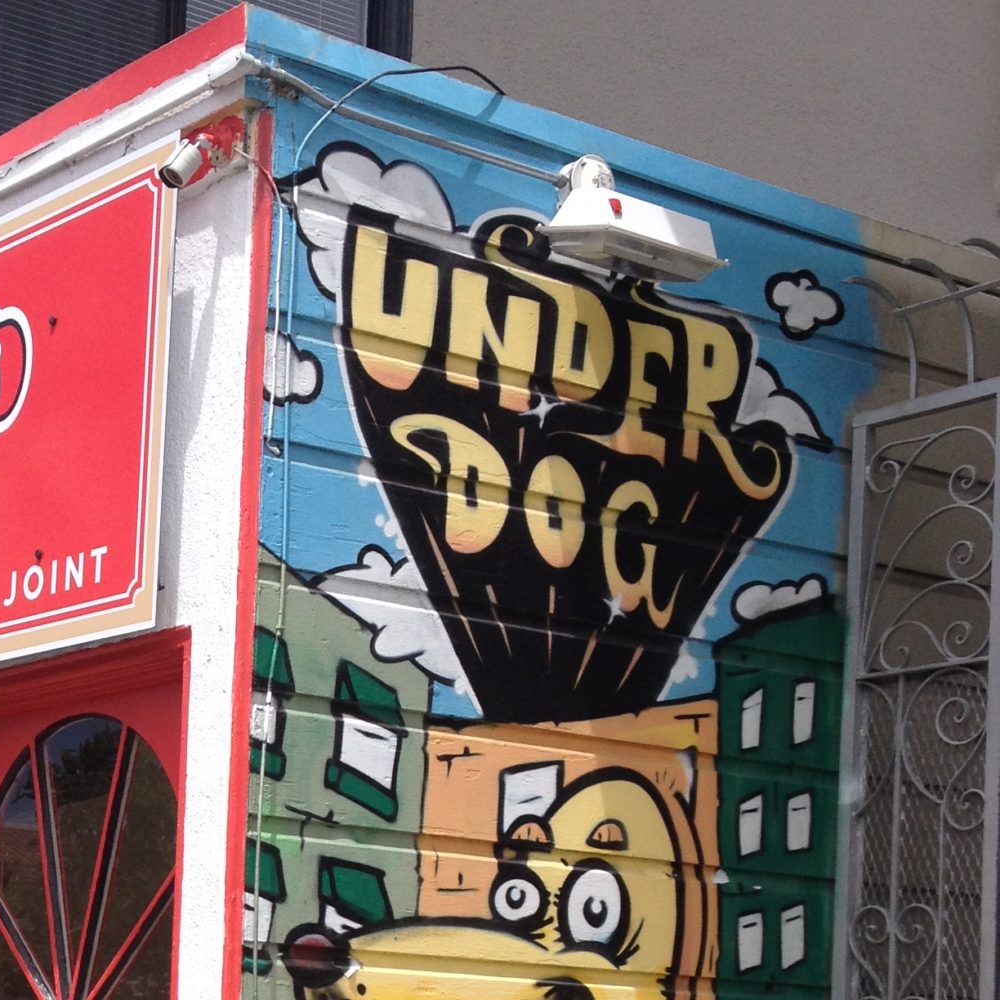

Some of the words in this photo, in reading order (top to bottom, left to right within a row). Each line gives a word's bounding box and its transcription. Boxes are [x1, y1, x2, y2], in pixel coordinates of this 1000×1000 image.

[352, 224, 782, 500] UNDER
[3, 546, 110, 606] JOINT
[390, 413, 684, 629] DOG
